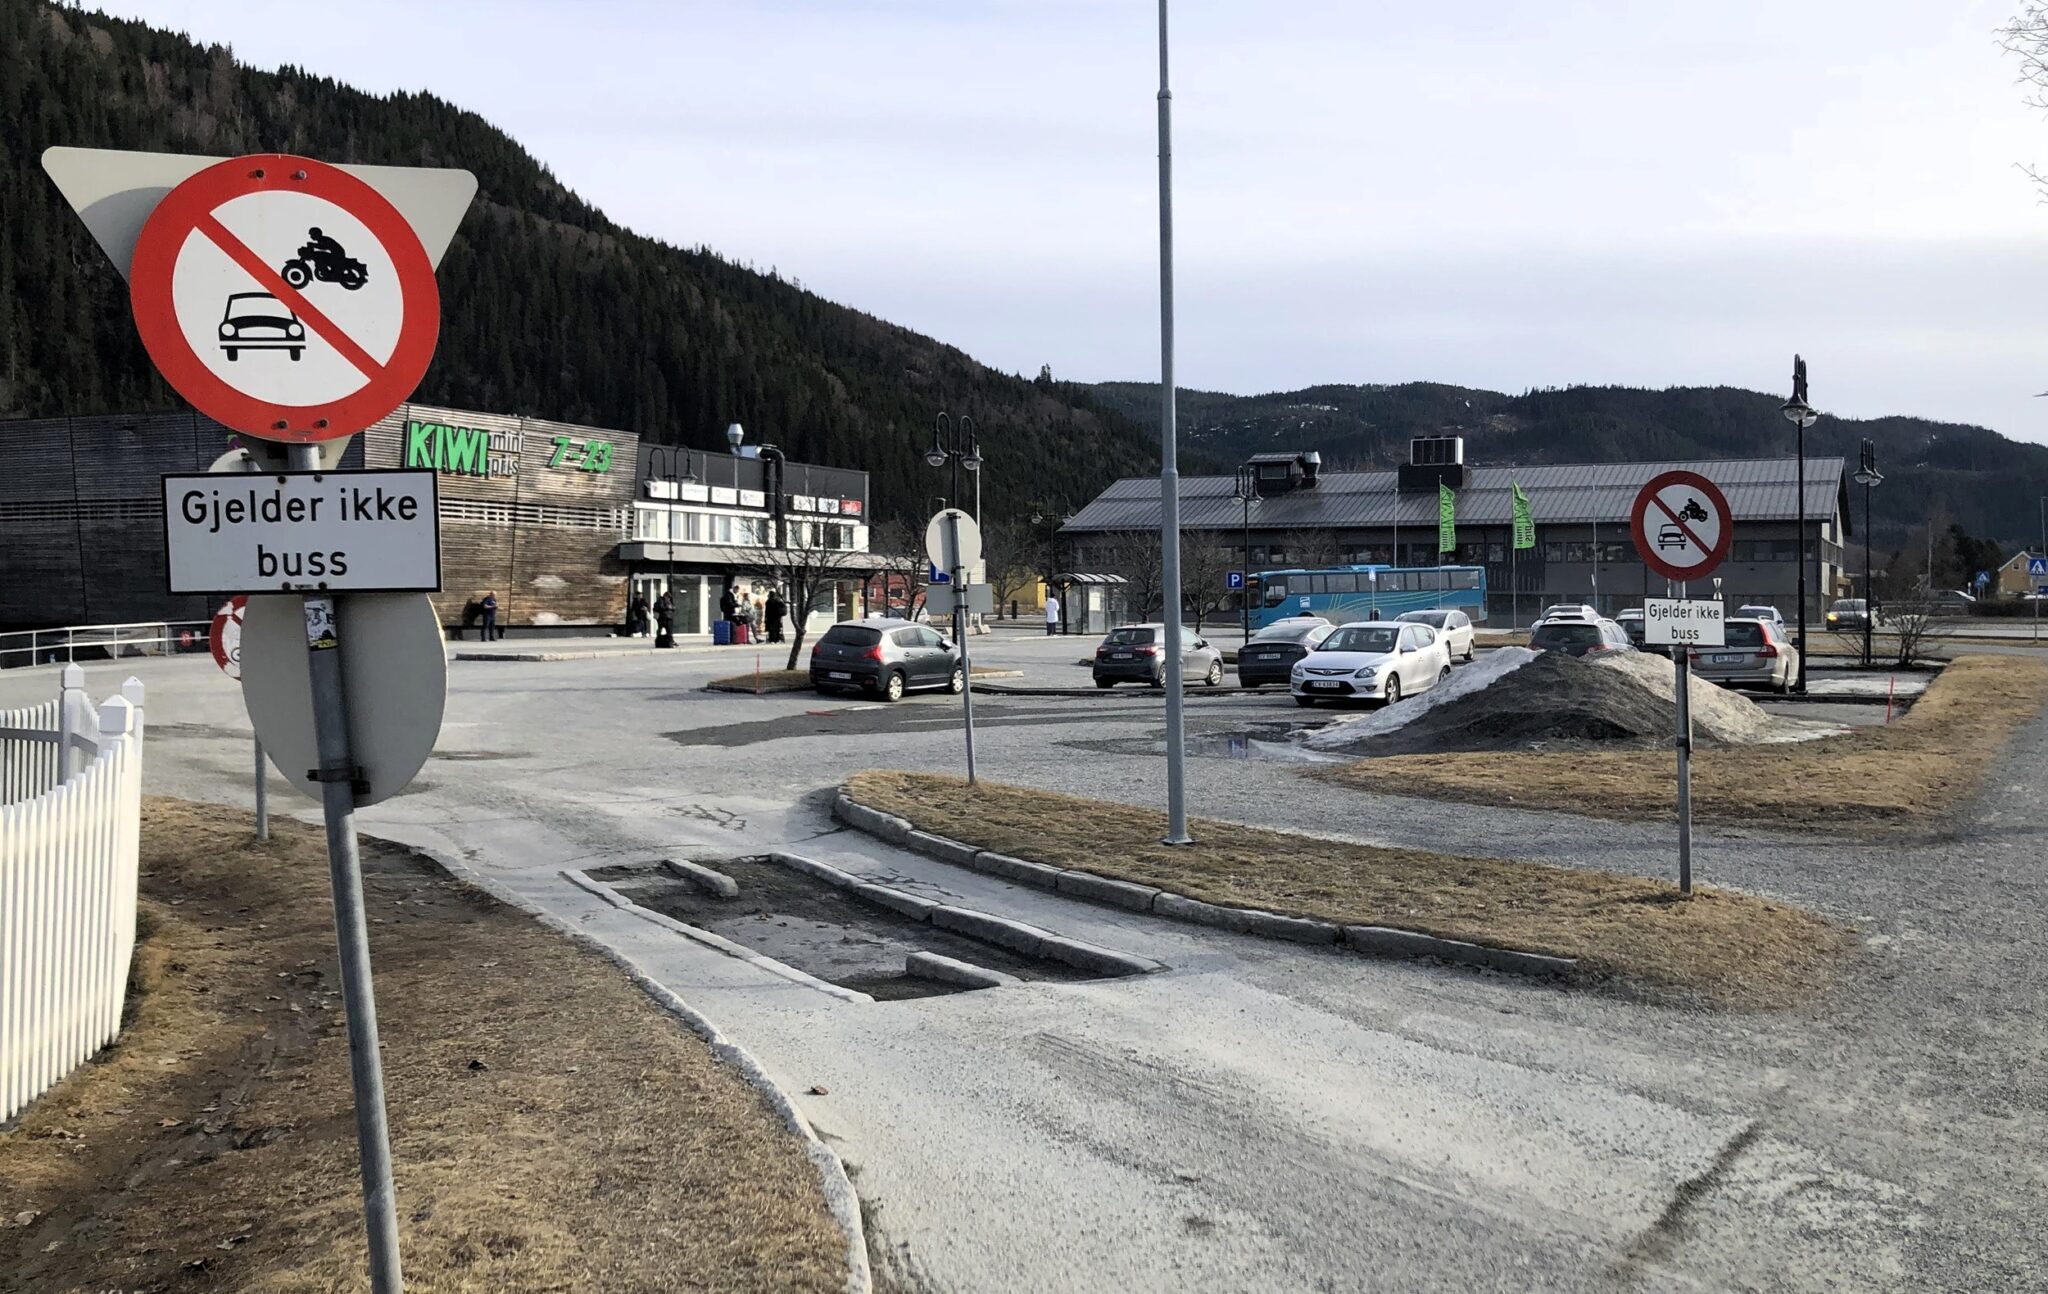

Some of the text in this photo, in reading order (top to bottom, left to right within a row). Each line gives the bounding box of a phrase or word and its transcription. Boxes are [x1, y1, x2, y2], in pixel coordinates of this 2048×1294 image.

[407, 420, 490, 475] KIWI
[490, 429, 524, 452] mini
[488, 453, 520, 479] pris
[181, 487, 418, 533] Gjelder ikke
[257, 544, 348, 577] buss
[1231, 573, 1240, 587] P
[1649, 603, 1720, 621] Gjelder ikke
[1671, 626, 1700, 640] buss
